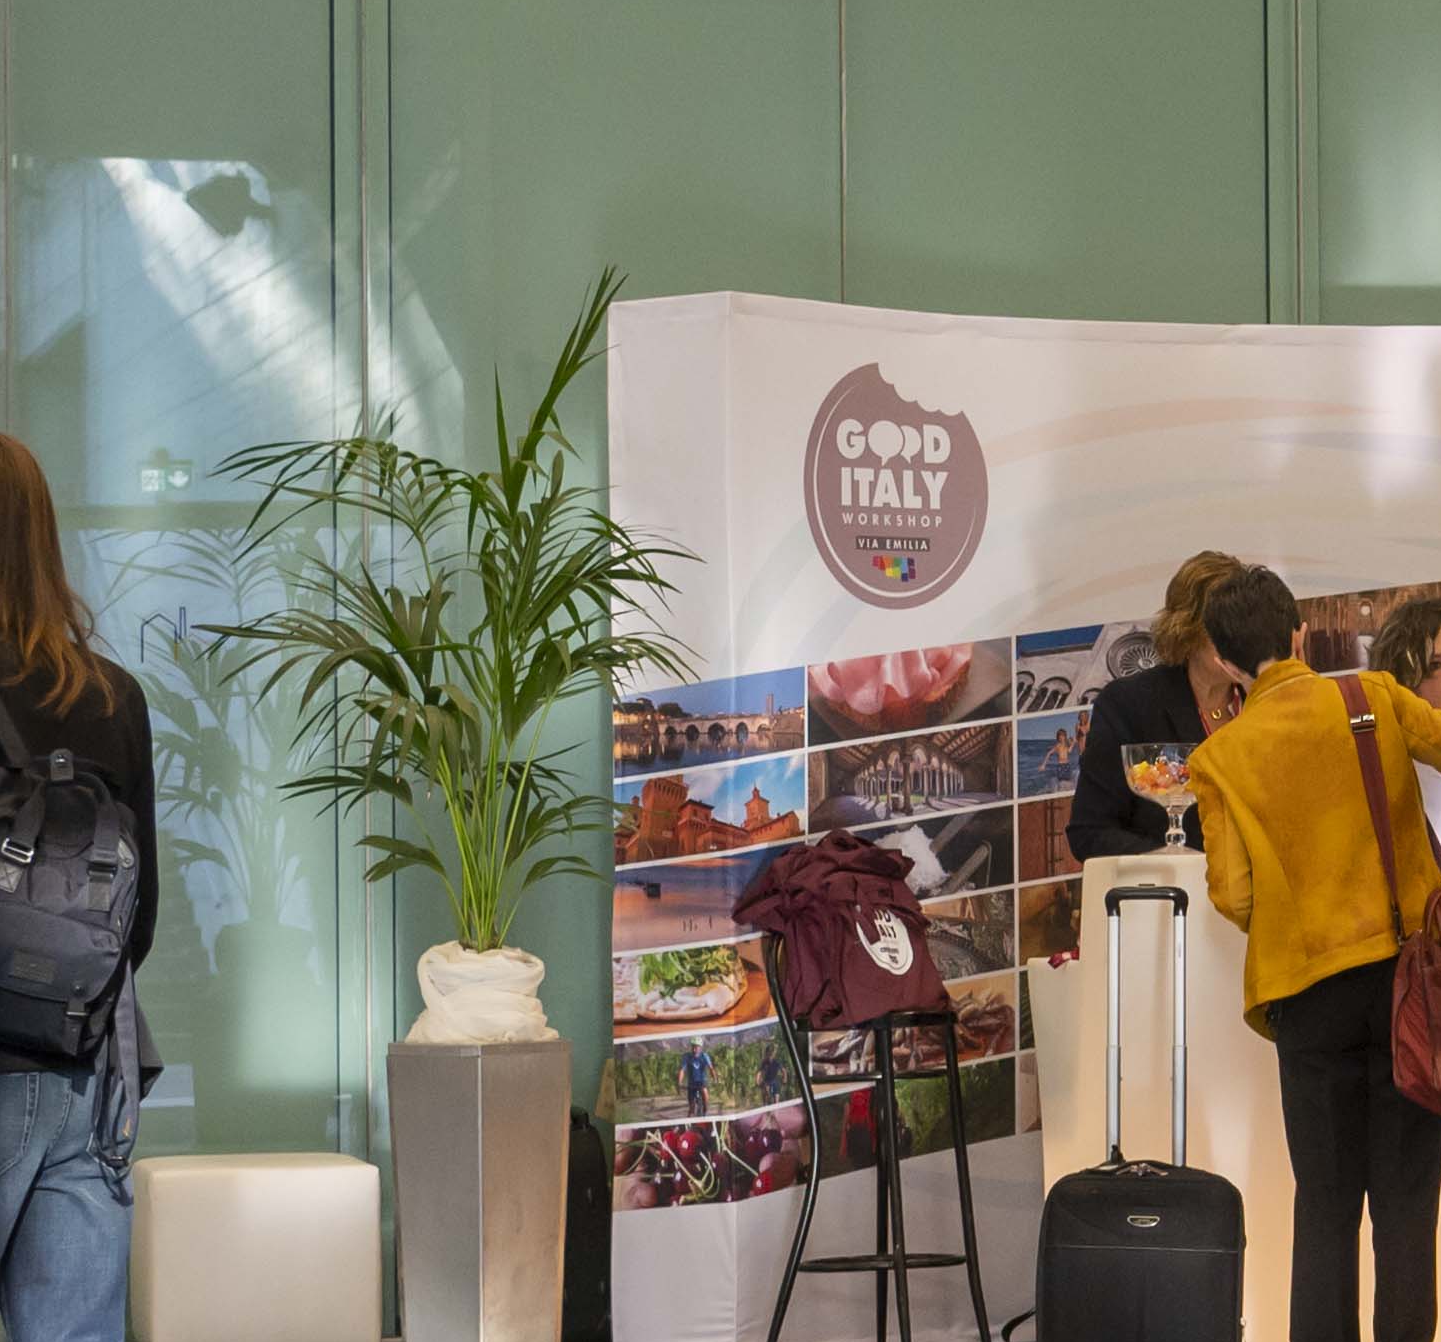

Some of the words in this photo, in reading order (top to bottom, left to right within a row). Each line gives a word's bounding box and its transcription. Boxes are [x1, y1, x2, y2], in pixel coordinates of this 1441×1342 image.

[836, 418, 951, 466] GOOD
[840, 467, 949, 510] ITALY
[842, 512, 943, 528] WORKSHOP
[857, 538, 879, 549] VIA
[885, 539, 929, 550] EMILIA
